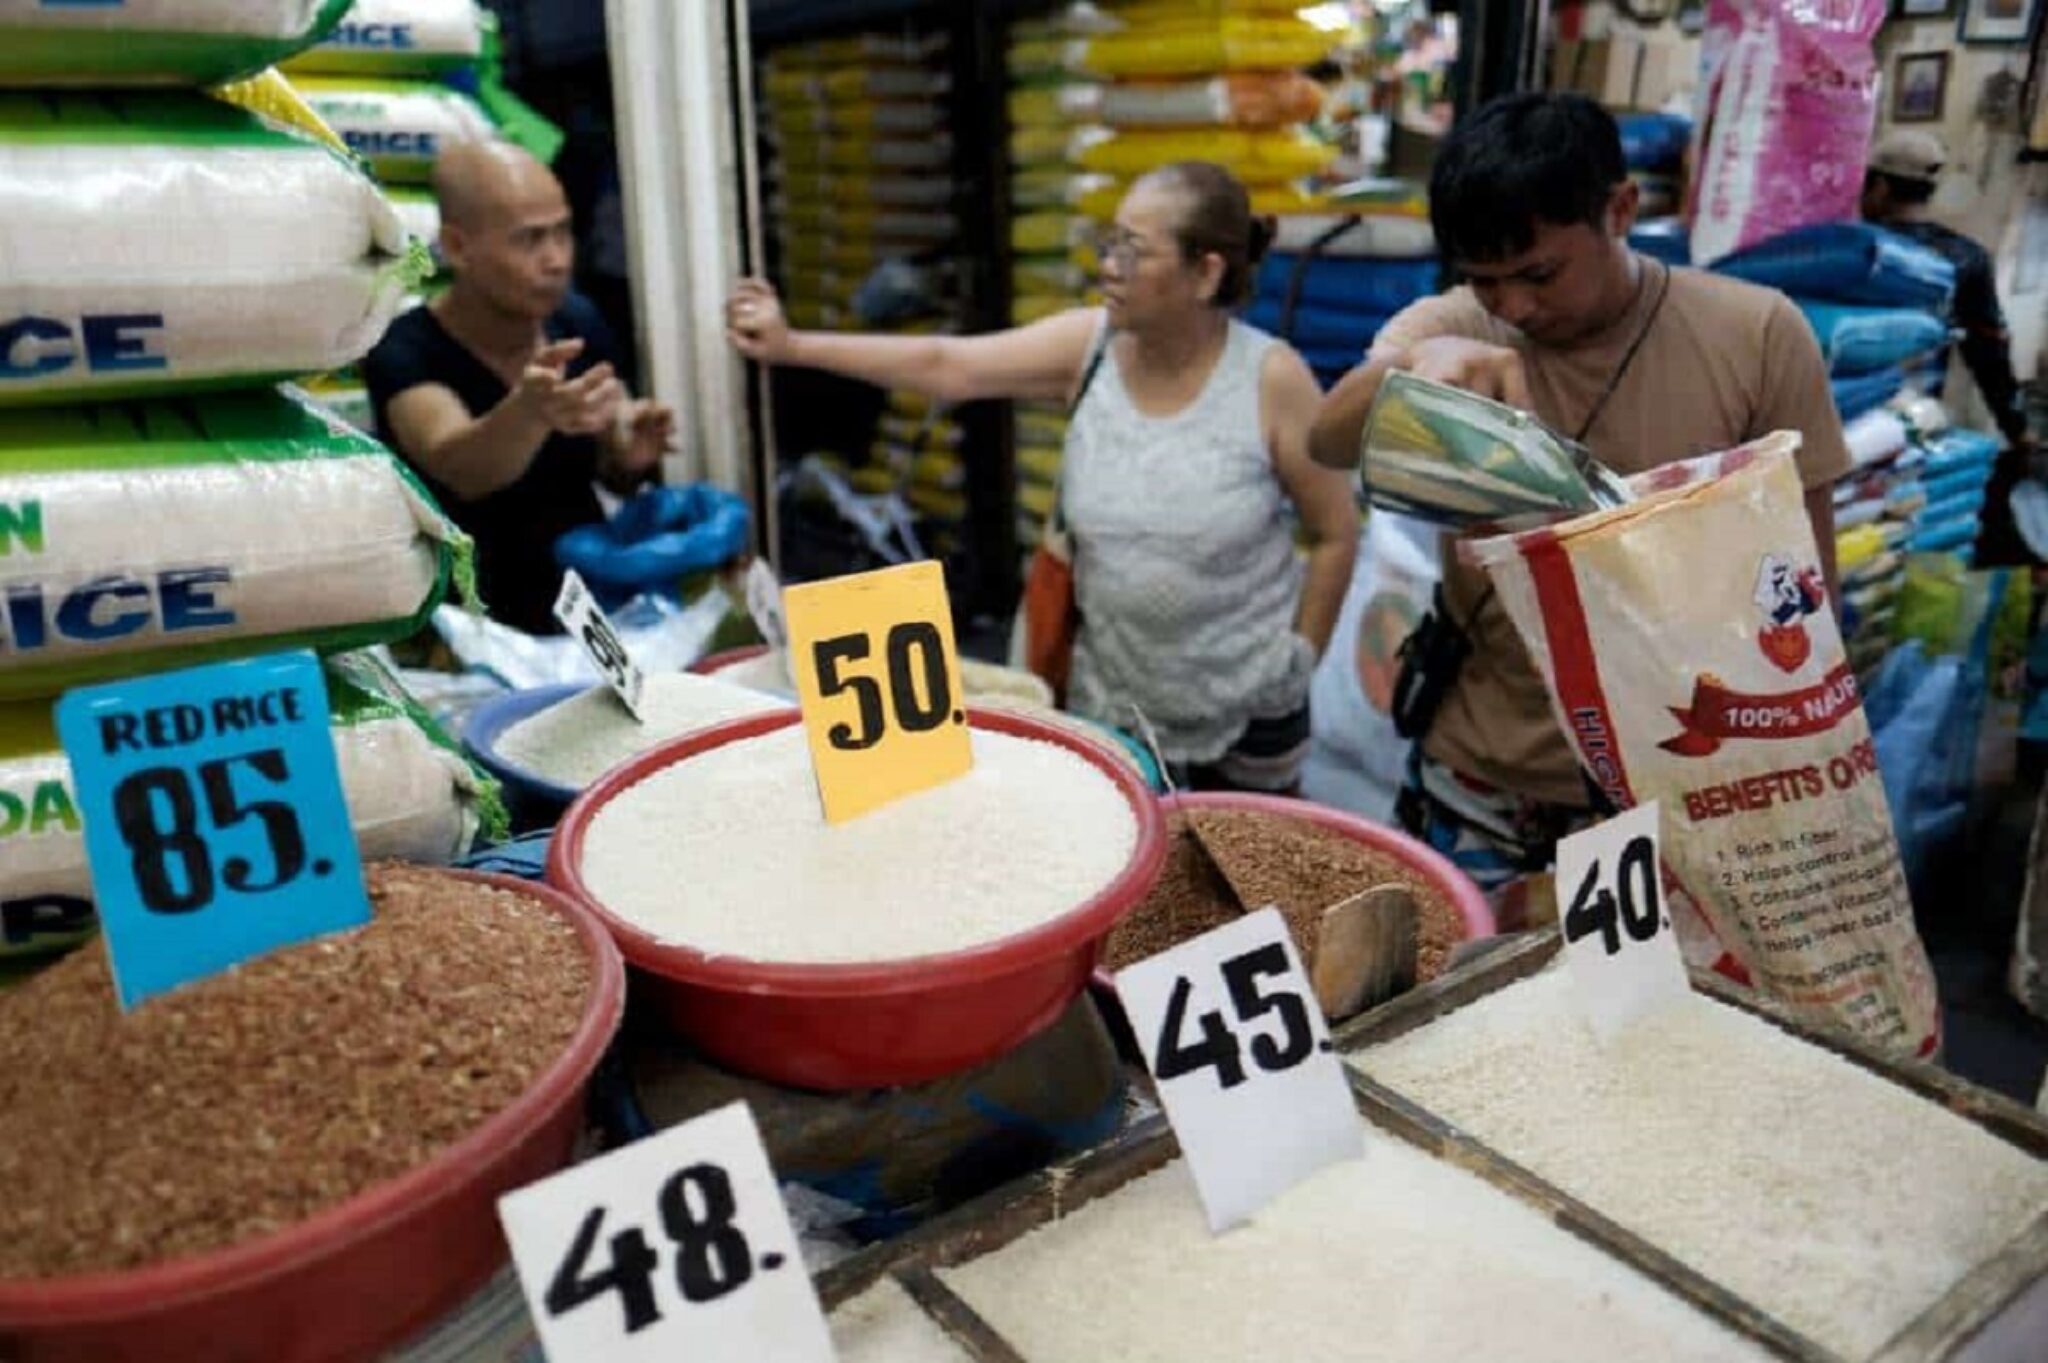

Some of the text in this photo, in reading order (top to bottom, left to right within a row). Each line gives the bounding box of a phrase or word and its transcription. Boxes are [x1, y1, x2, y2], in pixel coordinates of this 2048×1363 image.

[98, 687, 304, 756] RED RICE
[1727, 705, 1800, 728] 100%
[1683, 765, 1824, 822] BENEFITS
